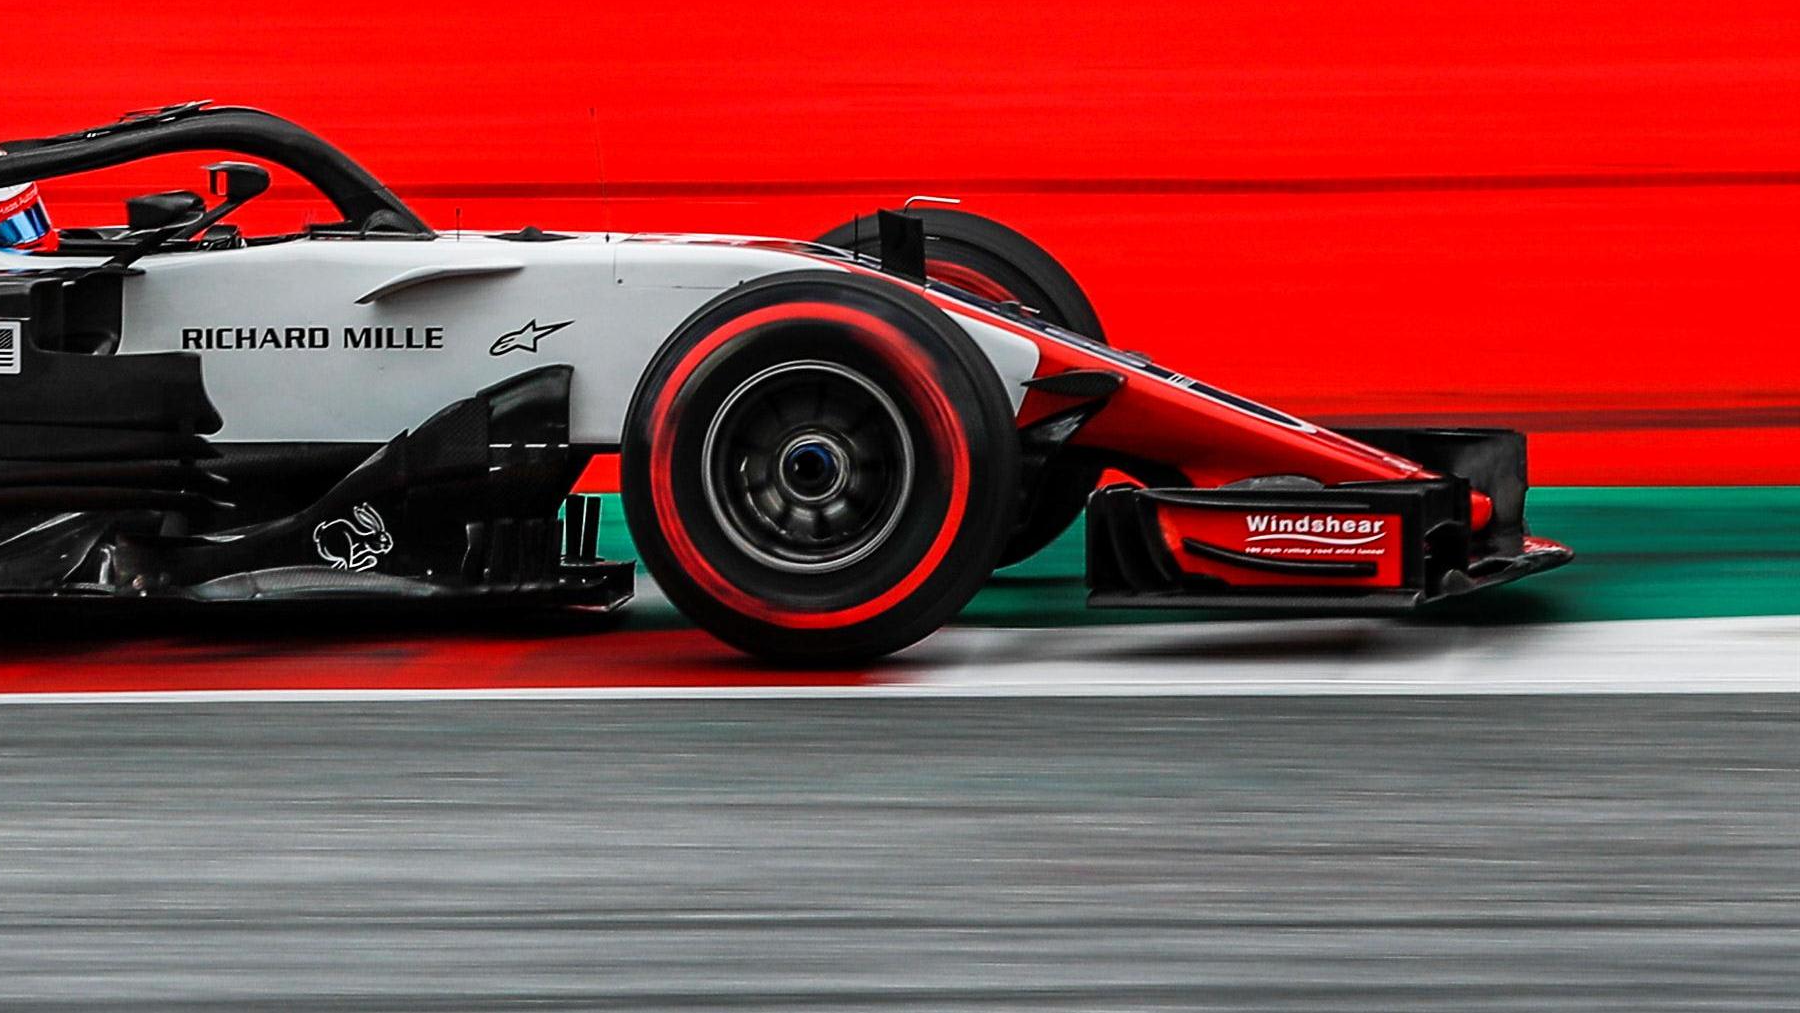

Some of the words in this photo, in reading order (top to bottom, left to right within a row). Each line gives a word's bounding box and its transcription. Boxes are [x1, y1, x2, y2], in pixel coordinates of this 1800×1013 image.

[182, 328, 329, 349] RICHARD
[344, 328, 444, 349] MILLE
[1246, 515, 1384, 533] Windshear
